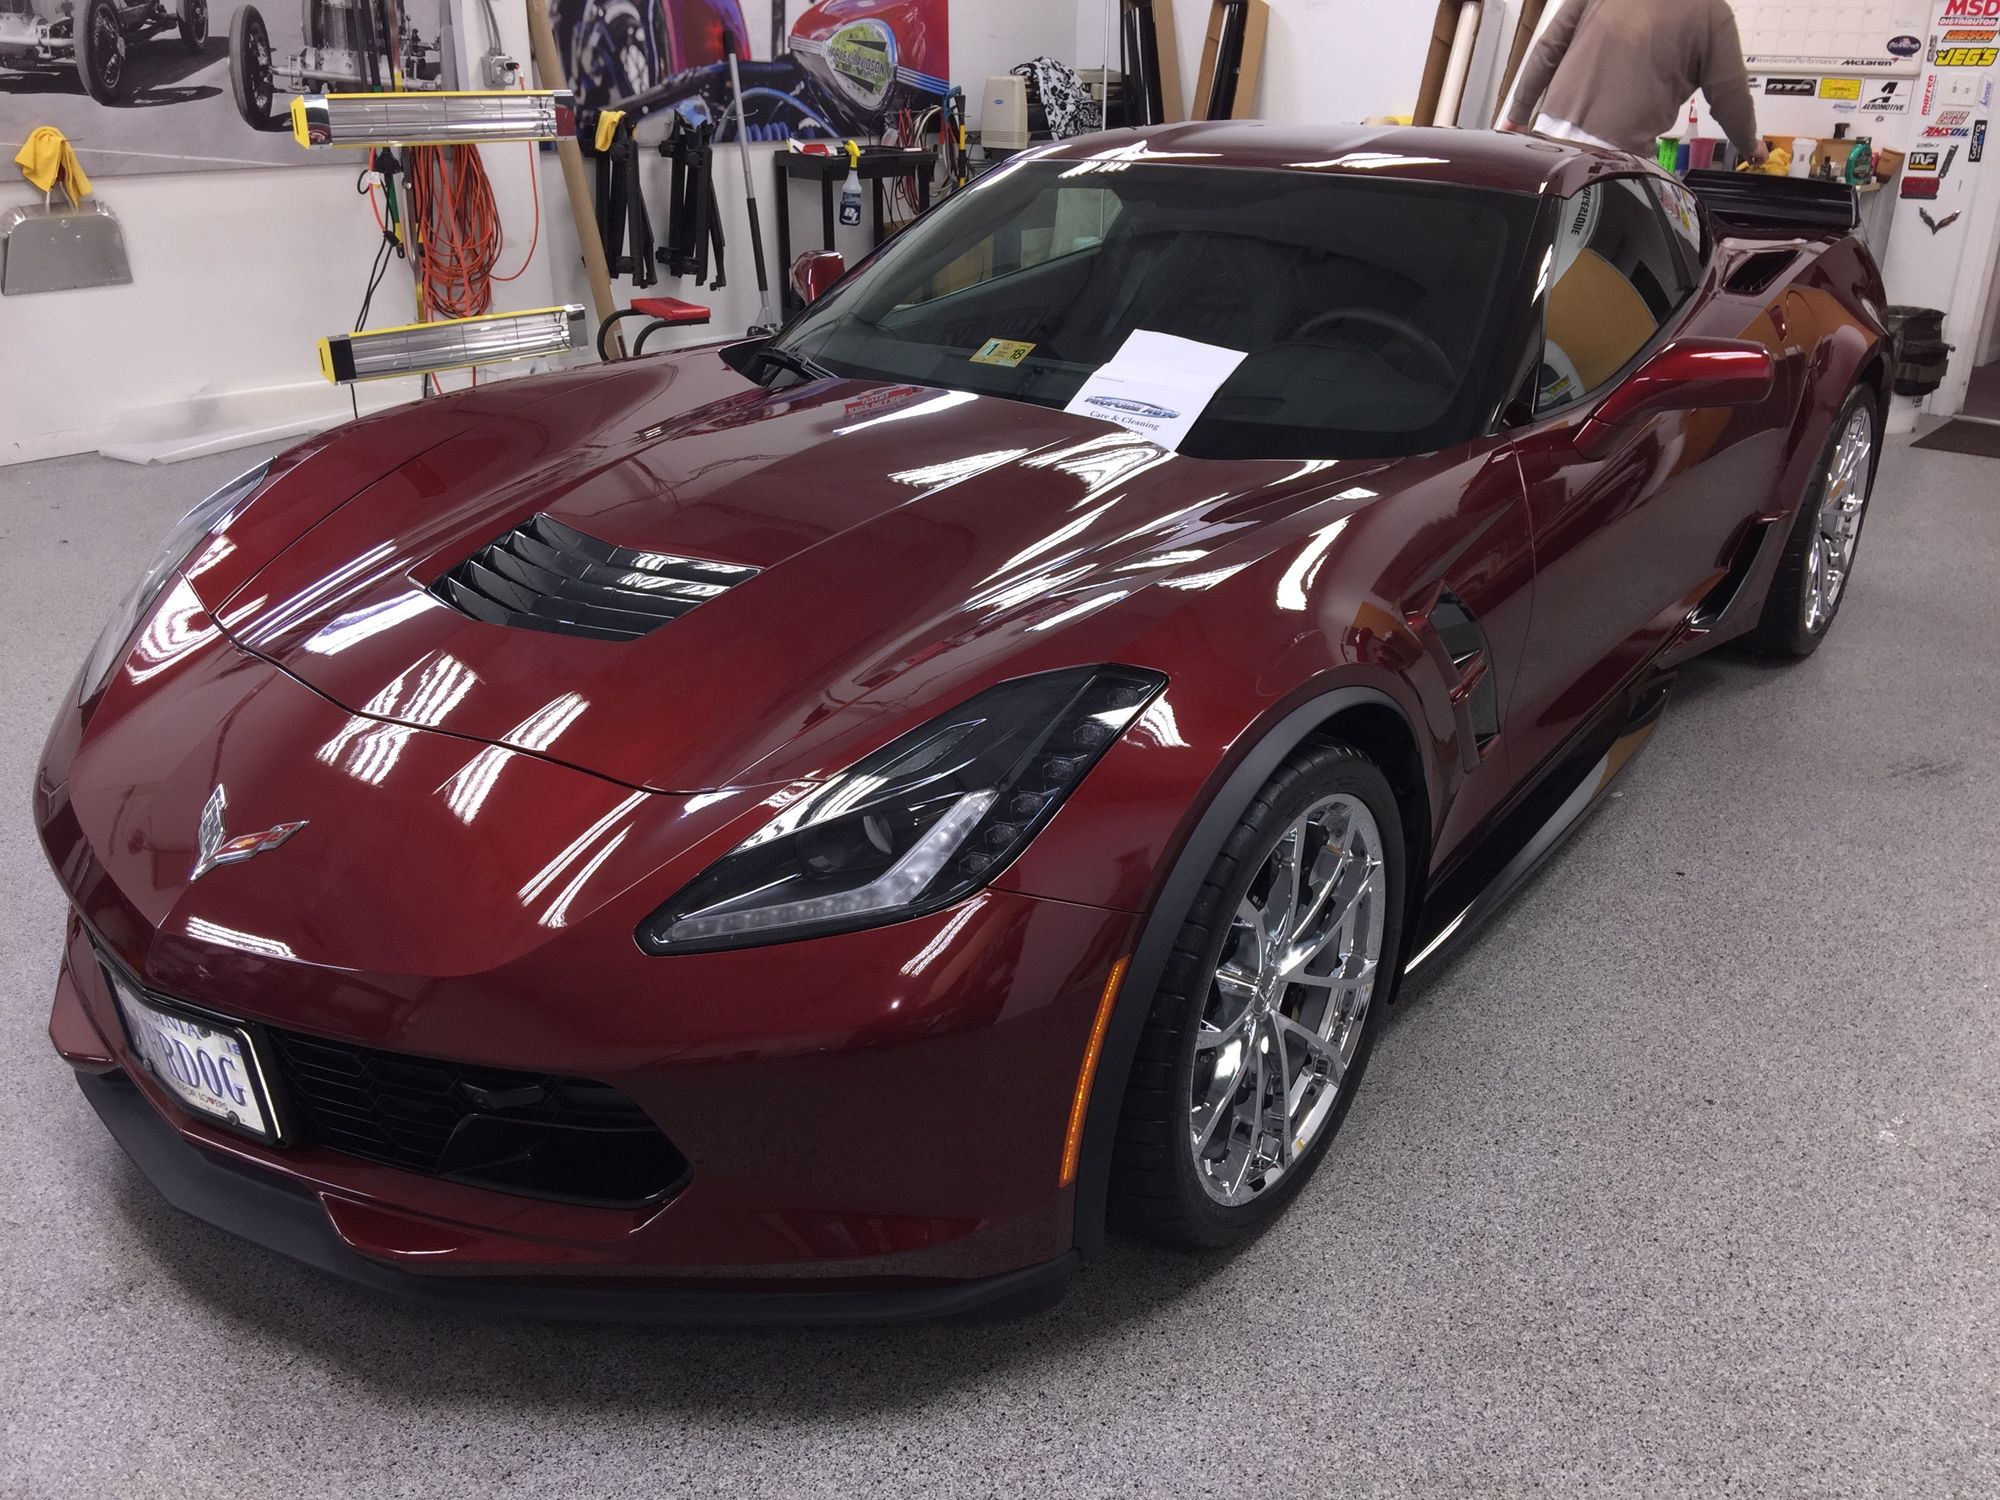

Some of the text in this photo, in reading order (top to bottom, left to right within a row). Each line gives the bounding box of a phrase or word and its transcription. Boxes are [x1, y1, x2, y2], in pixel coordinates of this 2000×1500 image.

[1944, 0, 2000, 16] MSD
[1862, 103, 1904, 111] AEROMOTIVE
[1922, 127, 1969, 137] AMSOIL
[1009, 348, 1025, 359] 18
[1089, 410, 1109, 419] Care
[1121, 416, 1160, 431] Cleaning
